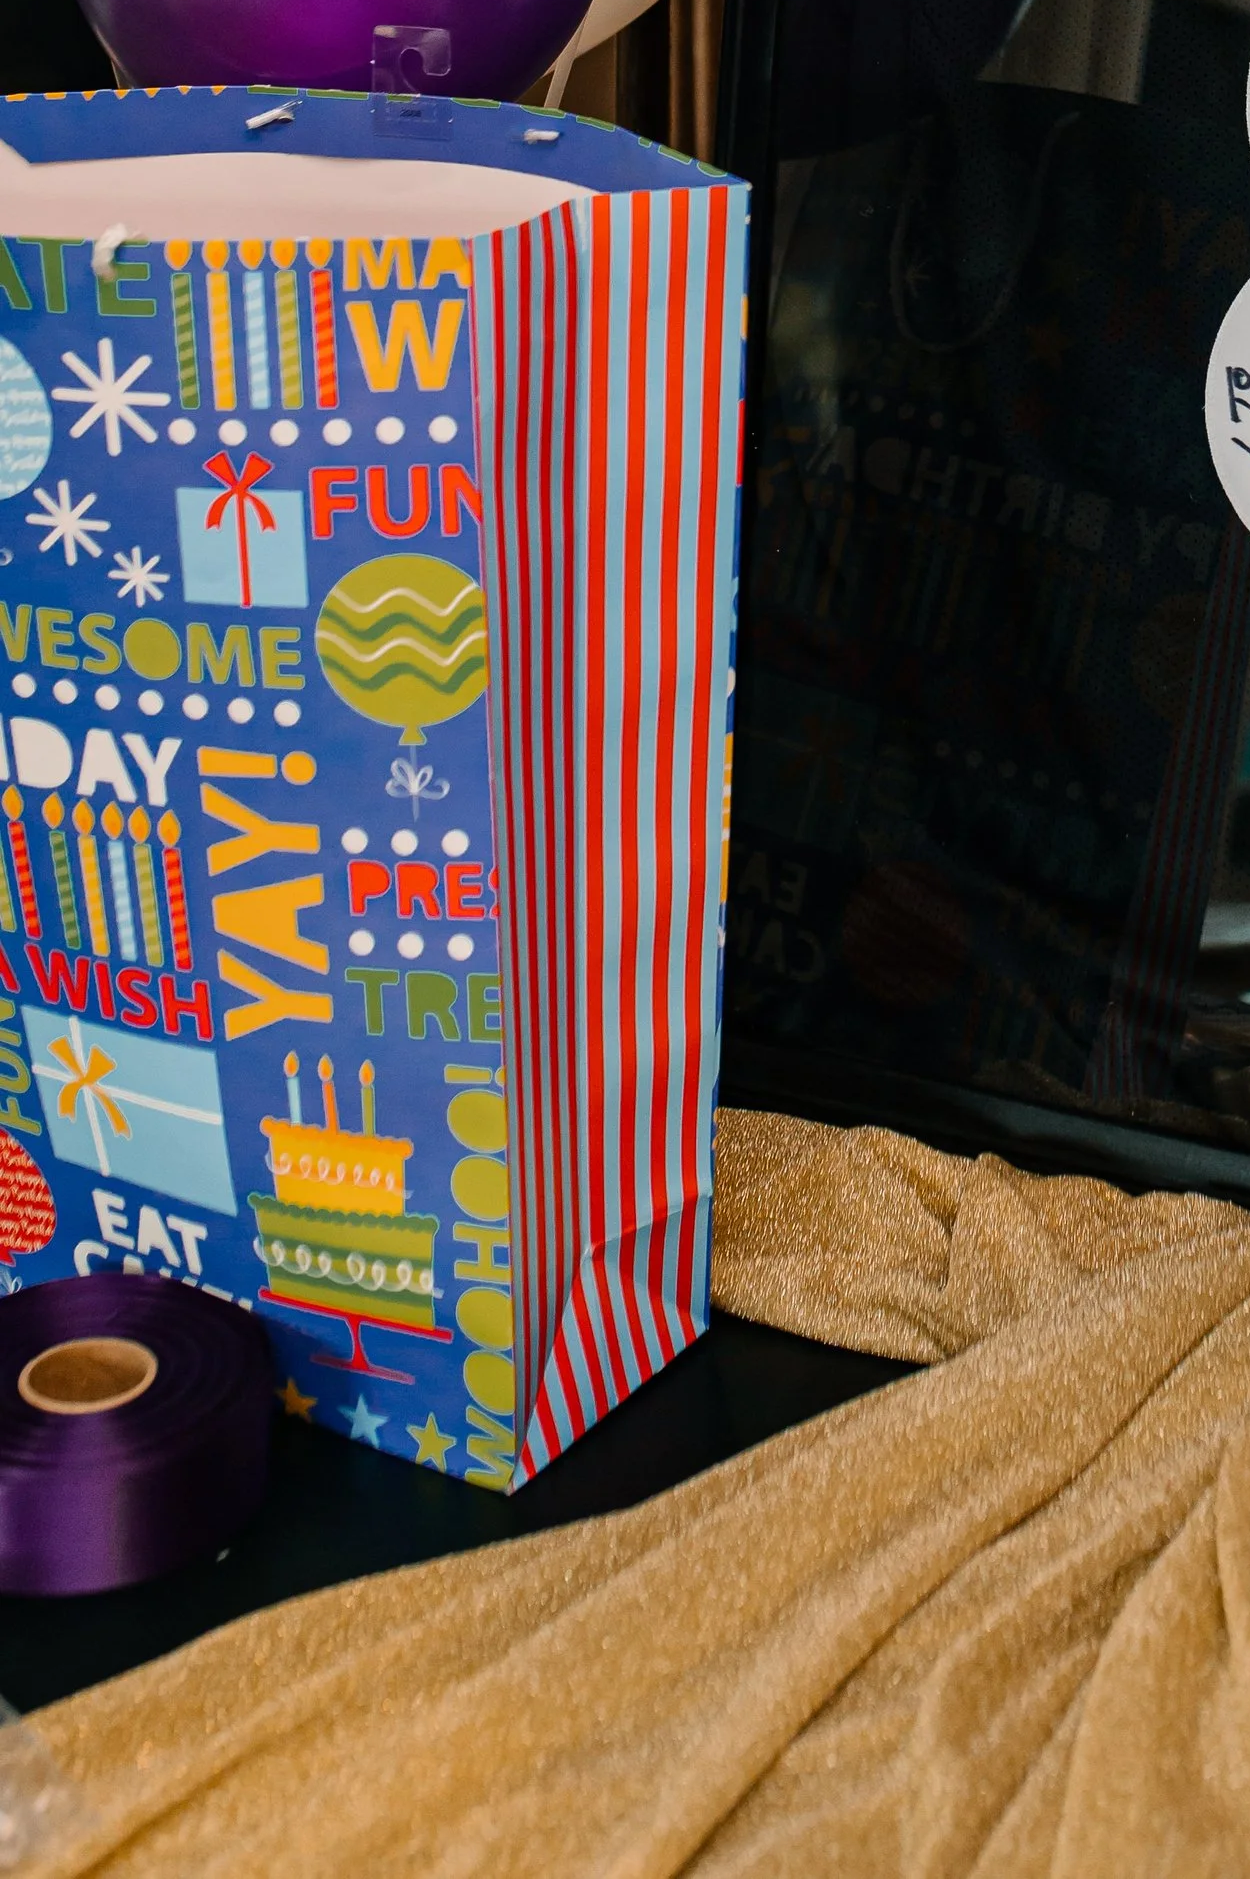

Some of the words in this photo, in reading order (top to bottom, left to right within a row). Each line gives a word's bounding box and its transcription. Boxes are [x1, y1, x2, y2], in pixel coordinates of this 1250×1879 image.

[345, 299, 466, 392] W
[308, 463, 483, 540] FUN
[0, 713, 183, 807] DAY
[197, 746, 334, 1041] YAY!
[24, 942, 214, 1041] WISH
[345, 967, 502, 1043] TRE
[91, 1187, 208, 1276] EAT
